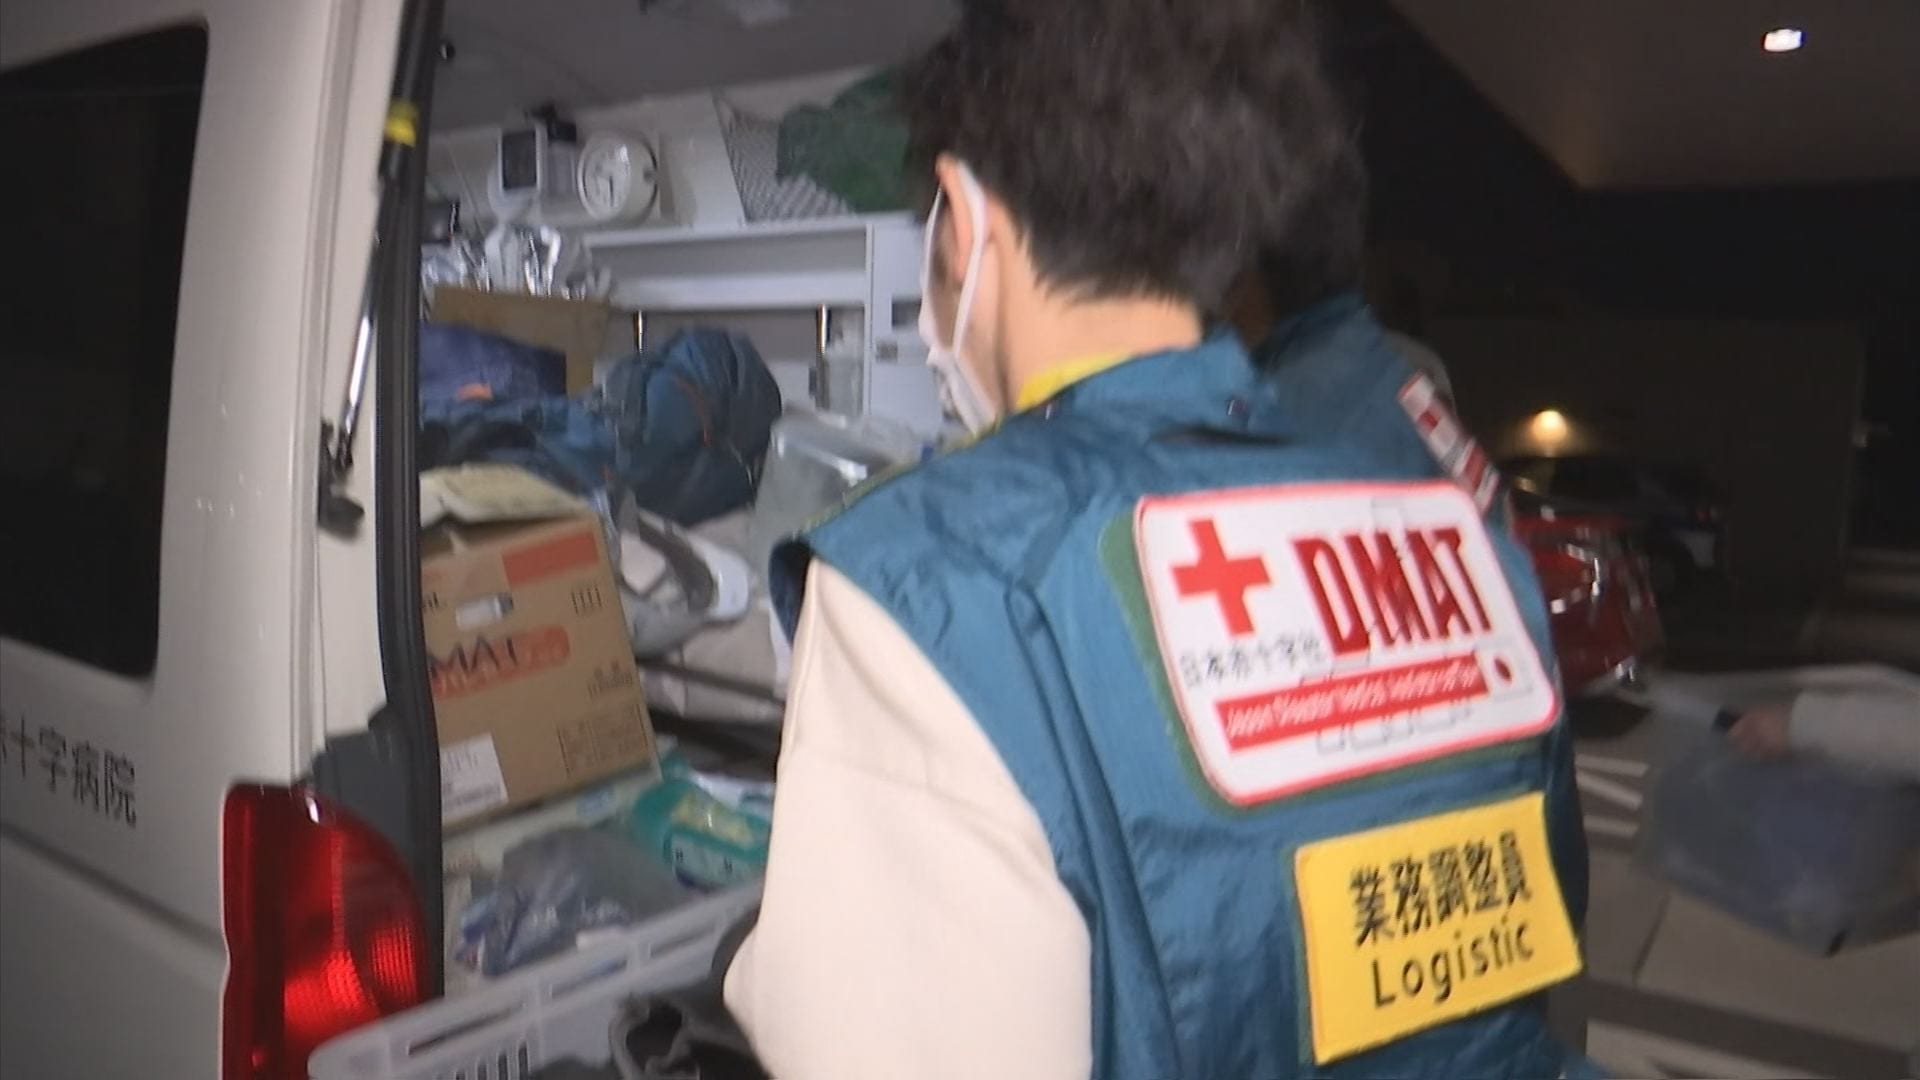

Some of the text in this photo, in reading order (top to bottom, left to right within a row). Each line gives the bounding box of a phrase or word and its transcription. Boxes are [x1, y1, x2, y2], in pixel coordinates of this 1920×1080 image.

[1291, 527, 1492, 656] DMAT
[0, 713, 137, 828] 十字病院
[1350, 832, 1532, 947] 業務調整員
[1372, 917, 1534, 1009] Logistic
